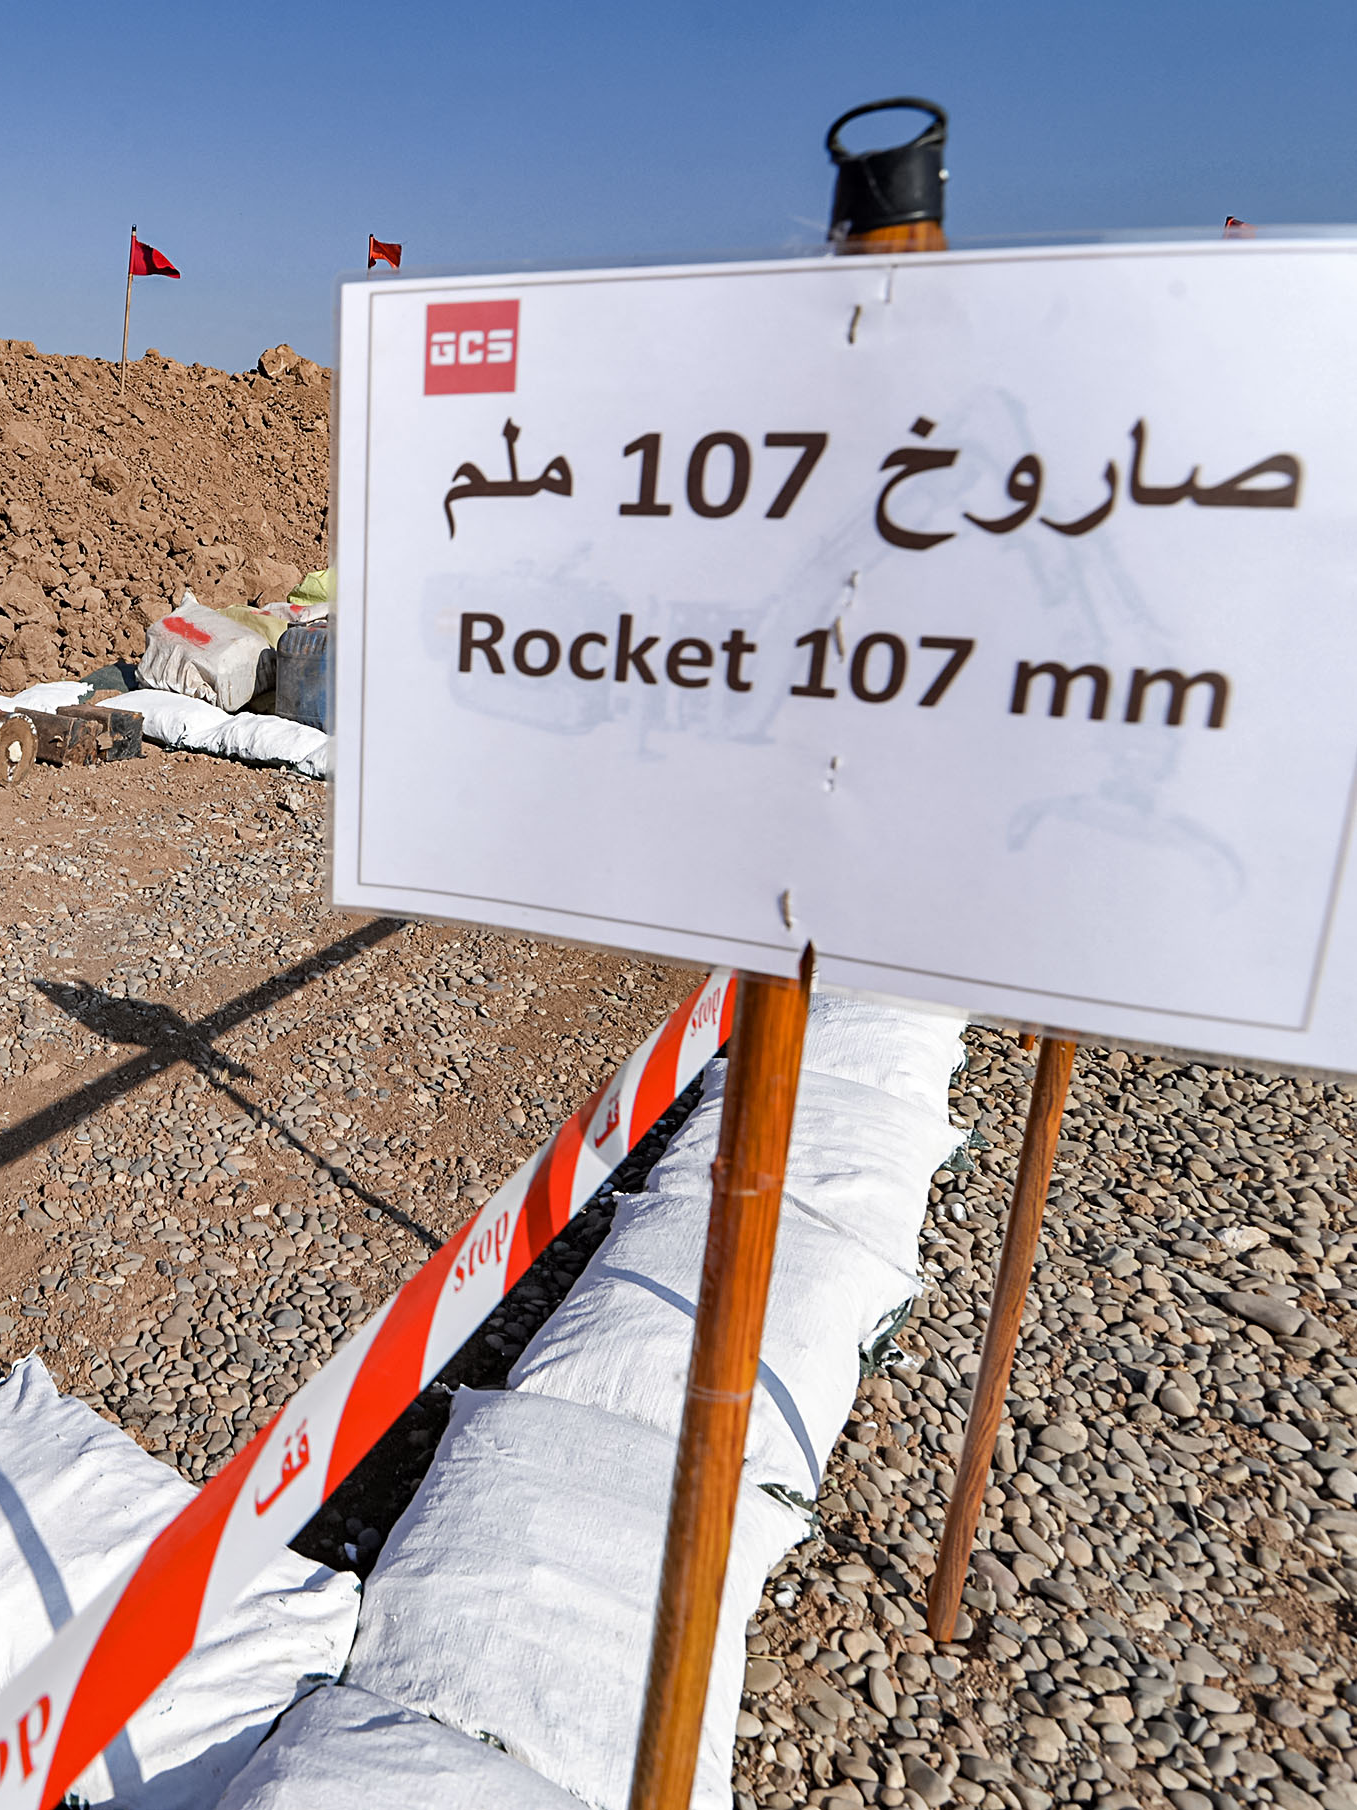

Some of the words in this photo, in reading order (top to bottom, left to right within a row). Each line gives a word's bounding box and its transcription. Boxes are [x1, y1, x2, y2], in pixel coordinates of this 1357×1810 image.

[430, 328, 514, 365] GCS
[443, 417, 573, 540] ملم
[618, 431, 829, 520] 107
[874, 416, 1301, 551] صاروخ
[458, 612, 757, 693] Rocket
[789, 623, 975, 708] 107
[1009, 660, 1230, 730] mm
[691, 987, 721, 1037] stop
[453, 1210, 509, 1292] stop
[255, 1418, 310, 1516] قف
